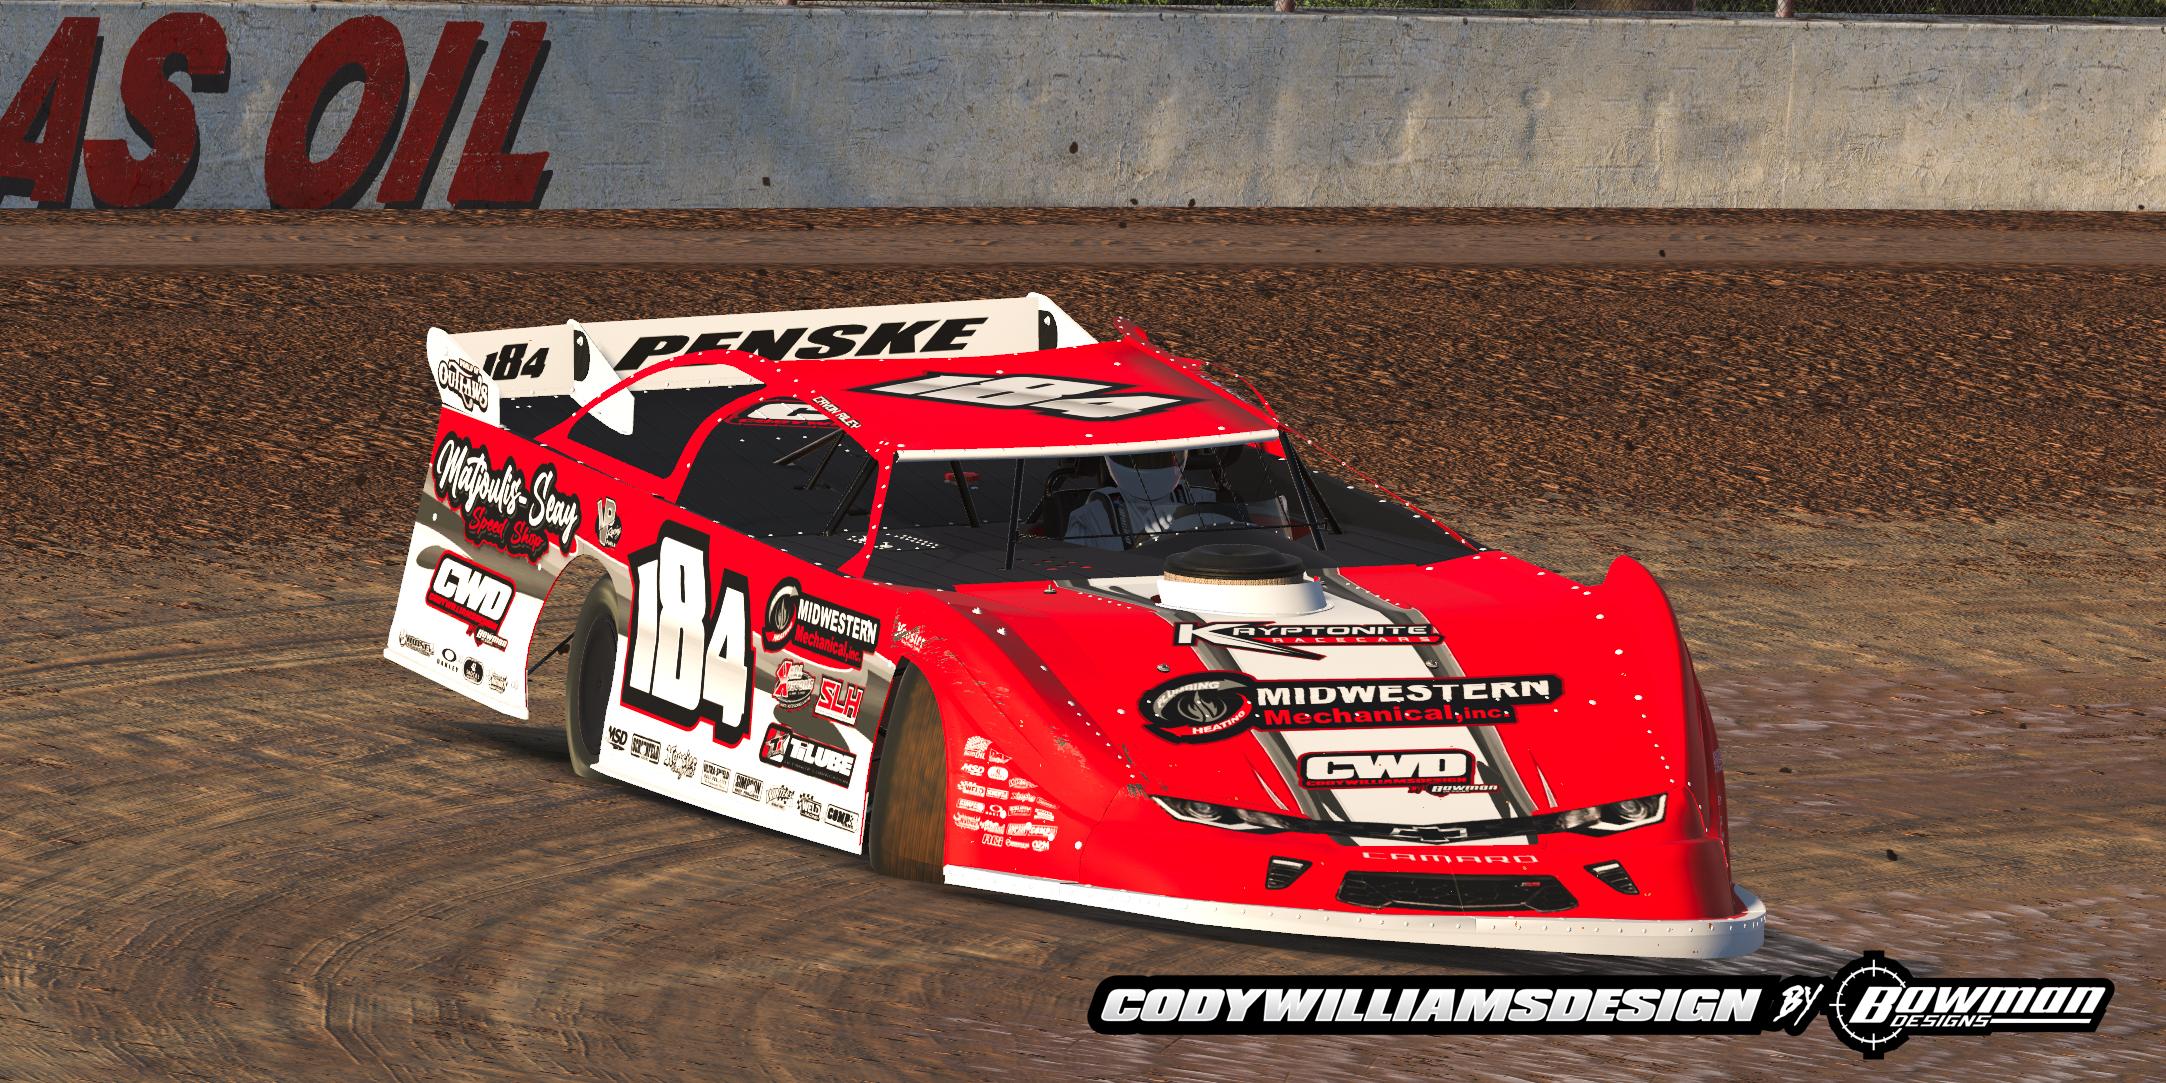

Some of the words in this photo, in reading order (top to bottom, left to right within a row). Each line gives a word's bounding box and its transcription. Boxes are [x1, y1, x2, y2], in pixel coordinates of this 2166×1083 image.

[264, 14, 551, 208] OIL
[614, 317, 989, 370] PENSKE
[483, 343, 549, 381] 184
[862, 374, 1187, 419] 184
[469, 506, 508, 537] Speed
[511, 521, 544, 551] Shop
[433, 558, 512, 621] CWD
[628, 535, 749, 728] 184
[797, 598, 878, 645] MIDWESTERN
[1178, 622, 1428, 654] KRYPTONITE
[1271, 636, 1431, 644] RACECARS
[817, 679, 863, 719] SLH
[1157, 680, 1220, 709] PLUMBING
[1256, 680, 1550, 706] MIDWESTERN
[608, 725, 628, 745] MSD
[1192, 710, 1246, 735] HEATING
[1306, 753, 1467, 780] CWD
[801, 801, 820, 814] WELD
[1362, 852, 1539, 863] CAMARO
